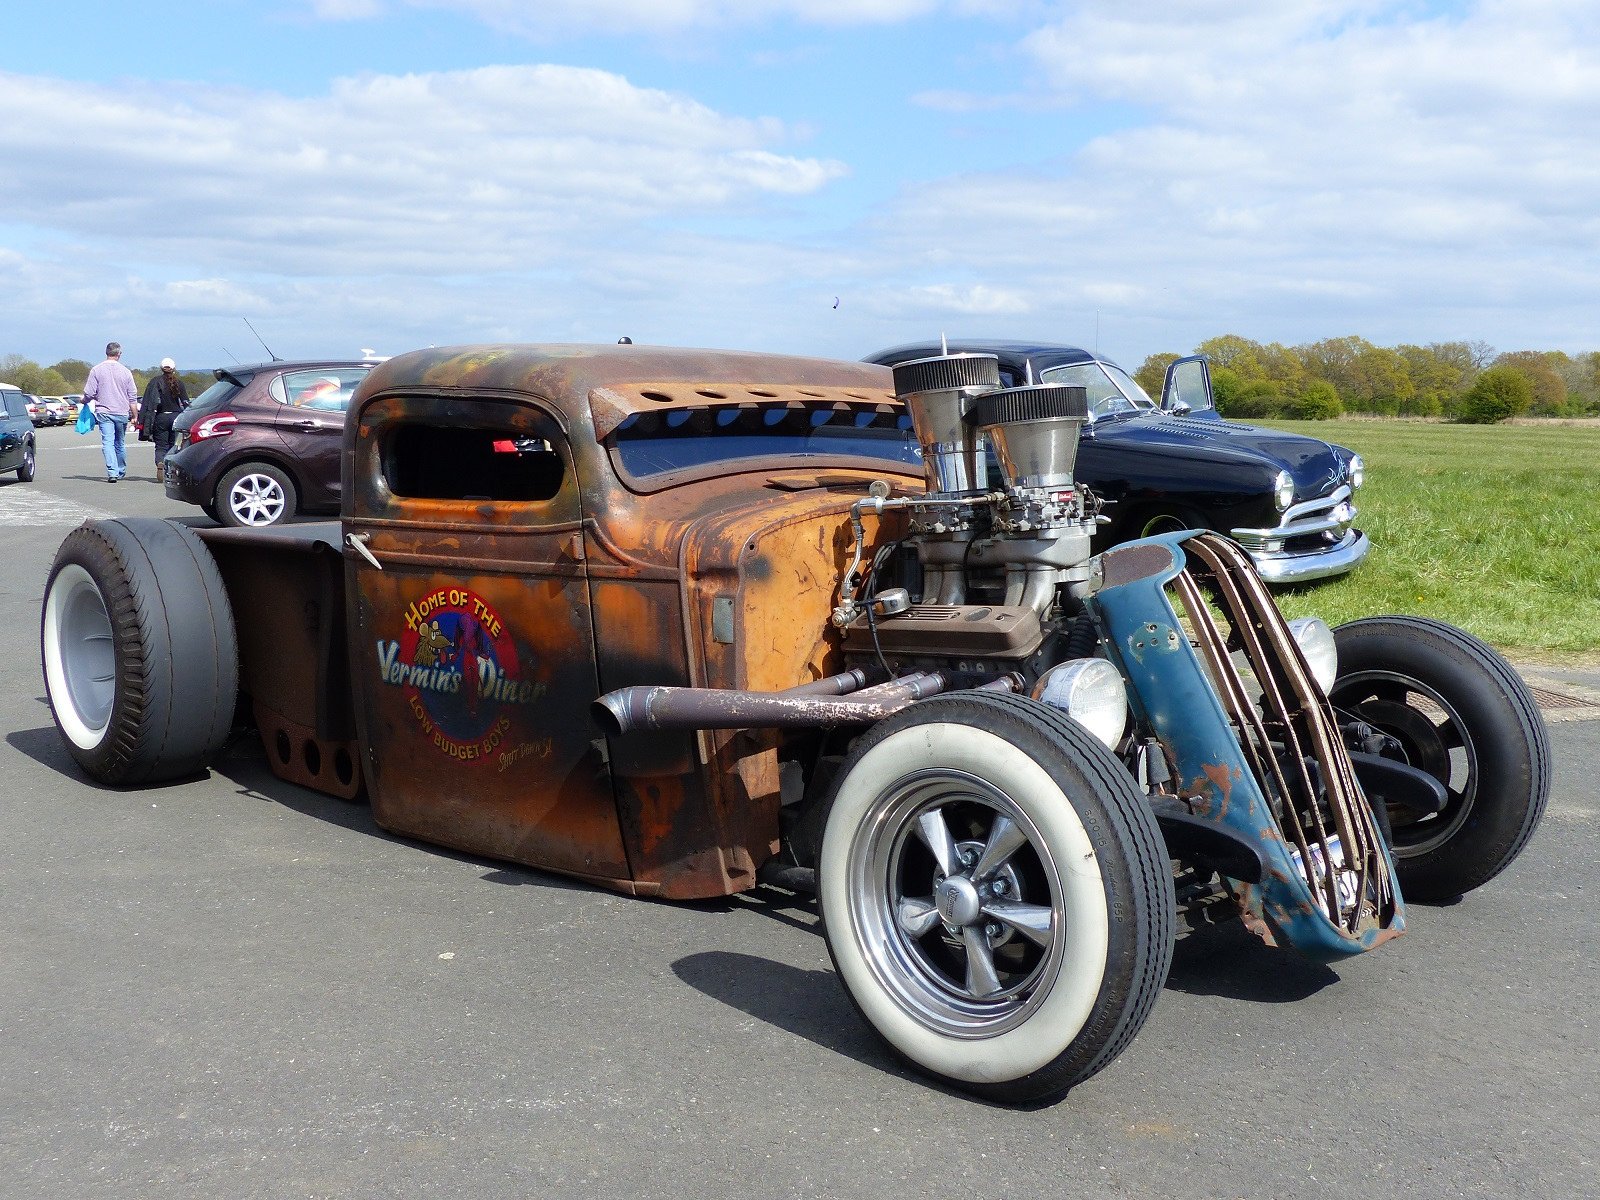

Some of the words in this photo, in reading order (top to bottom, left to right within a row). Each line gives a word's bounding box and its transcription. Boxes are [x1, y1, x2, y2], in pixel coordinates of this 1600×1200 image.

[404, 591, 447, 632] HOME
[449, 589, 468, 606] OF
[473, 597, 502, 638] THE
[376, 639, 463, 694] Vermin's
[476, 654, 548, 703] Diner
[408, 694, 433, 734] LOW
[433, 732, 480, 760] BUDGET
[482, 716, 511, 754] BOYS
